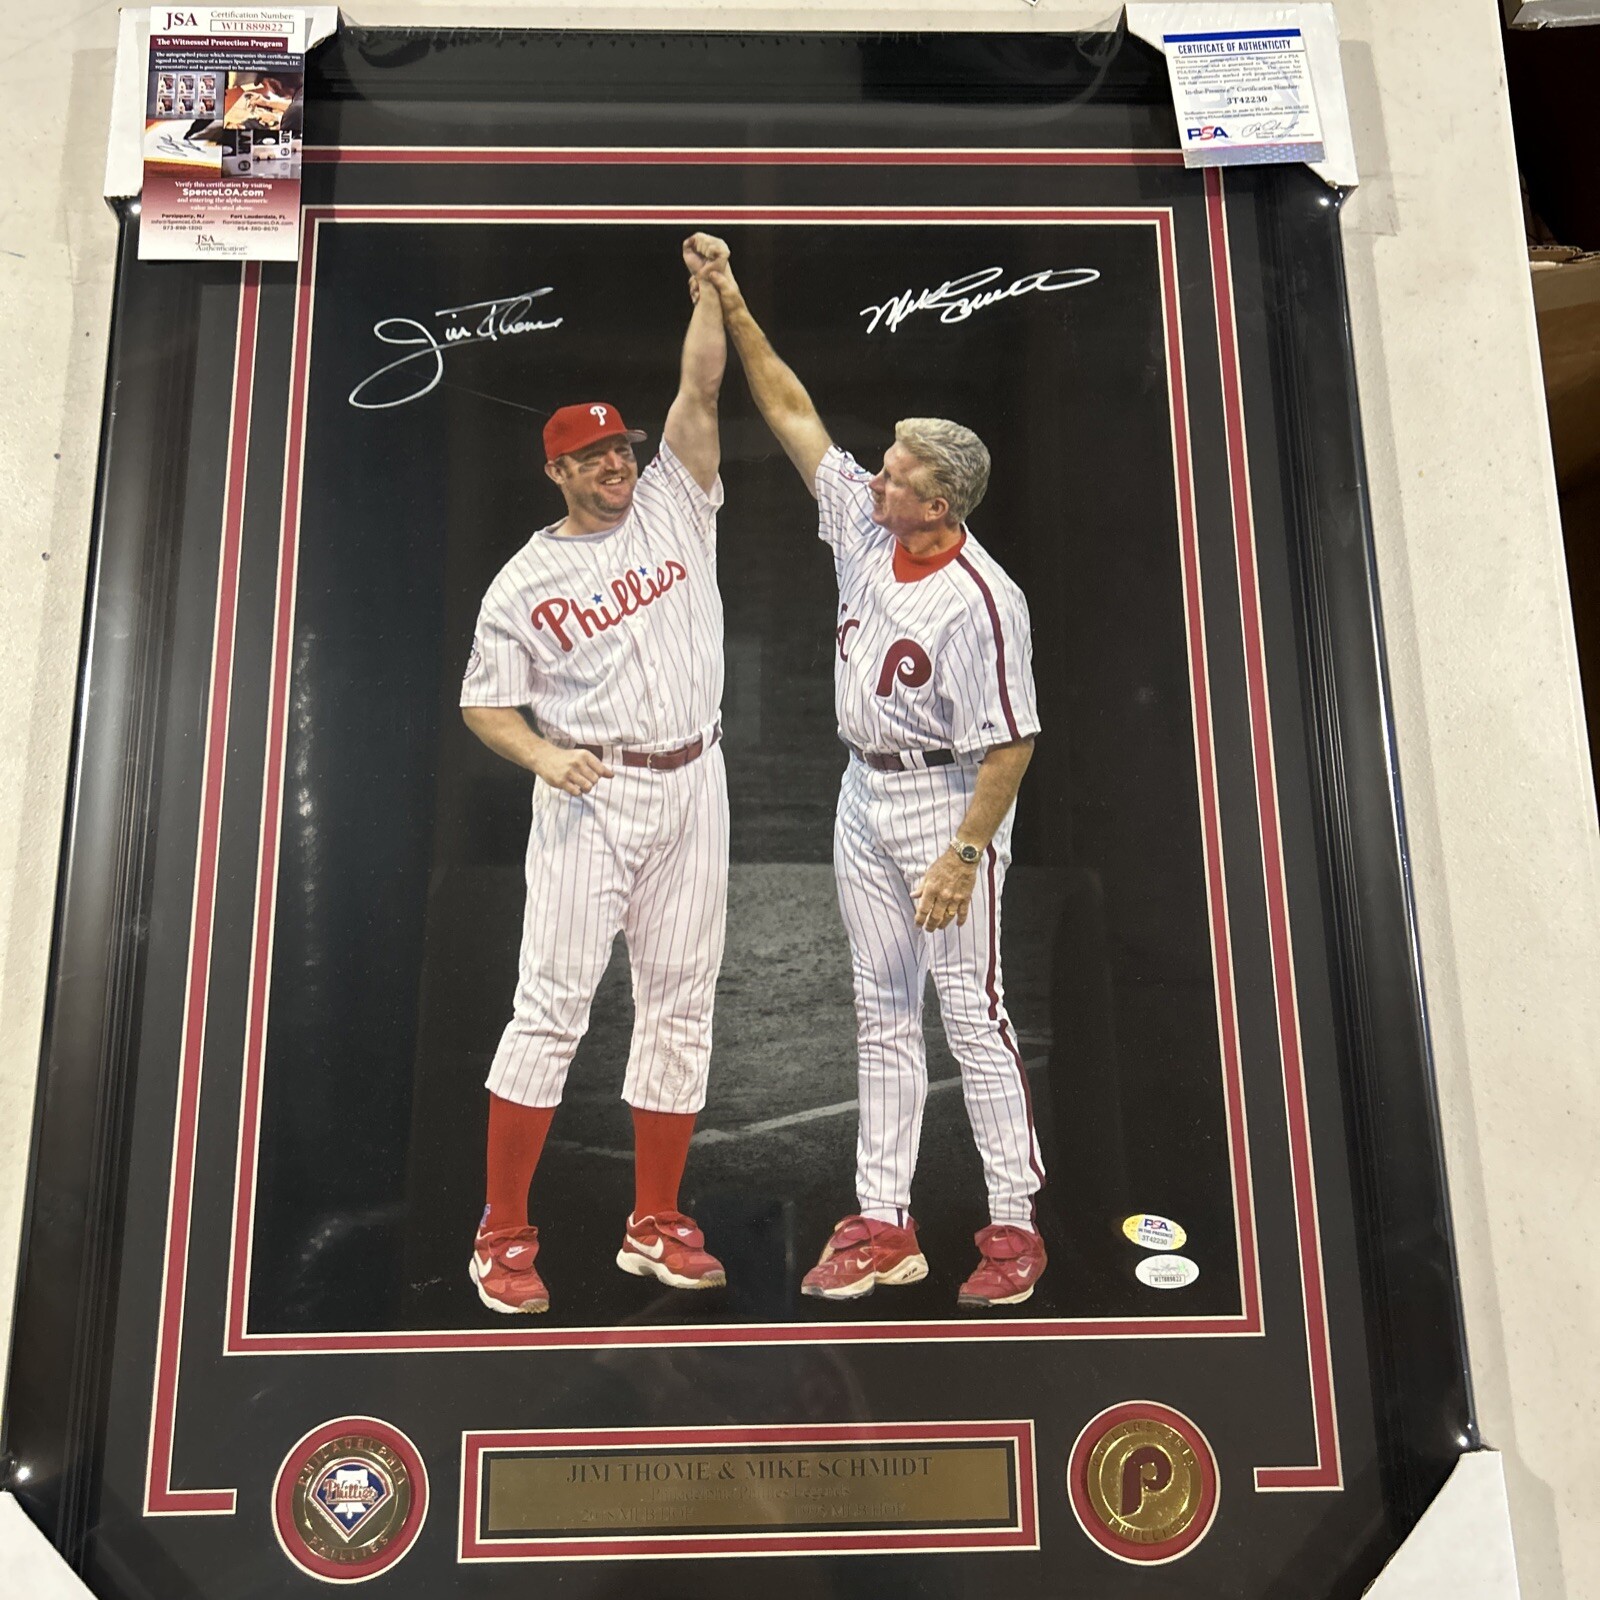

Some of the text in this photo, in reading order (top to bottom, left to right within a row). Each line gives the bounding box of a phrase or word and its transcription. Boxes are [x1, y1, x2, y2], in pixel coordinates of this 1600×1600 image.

[163, 12, 198, 31] JSA
[210, 11, 259, 19] Certification
[221, 22, 284, 32] WIT889822
[156, 38, 283, 48] The Witnessed Protection Program
[1178, 39, 1291, 55] CERTIFICATE OF AUTHENTICITY
[1226, 95, 1268, 105] 3T42230
[1187, 125, 1229, 141] PSA
[182, 188, 264, 197] SpenceLOA.com
[195, 234, 215, 245] JSA
[590, 405, 608, 427] P
[530, 560, 687, 653] Phillies
[875, 638, 933, 698] P
[1144, 1218, 1168, 1230] PSA
[566, 1456, 933, 1483] JIM THOME & MIKE SCHMIDT
[1120, 1445, 1174, 1517] P
[322, 1478, 379, 1503] Phillies
